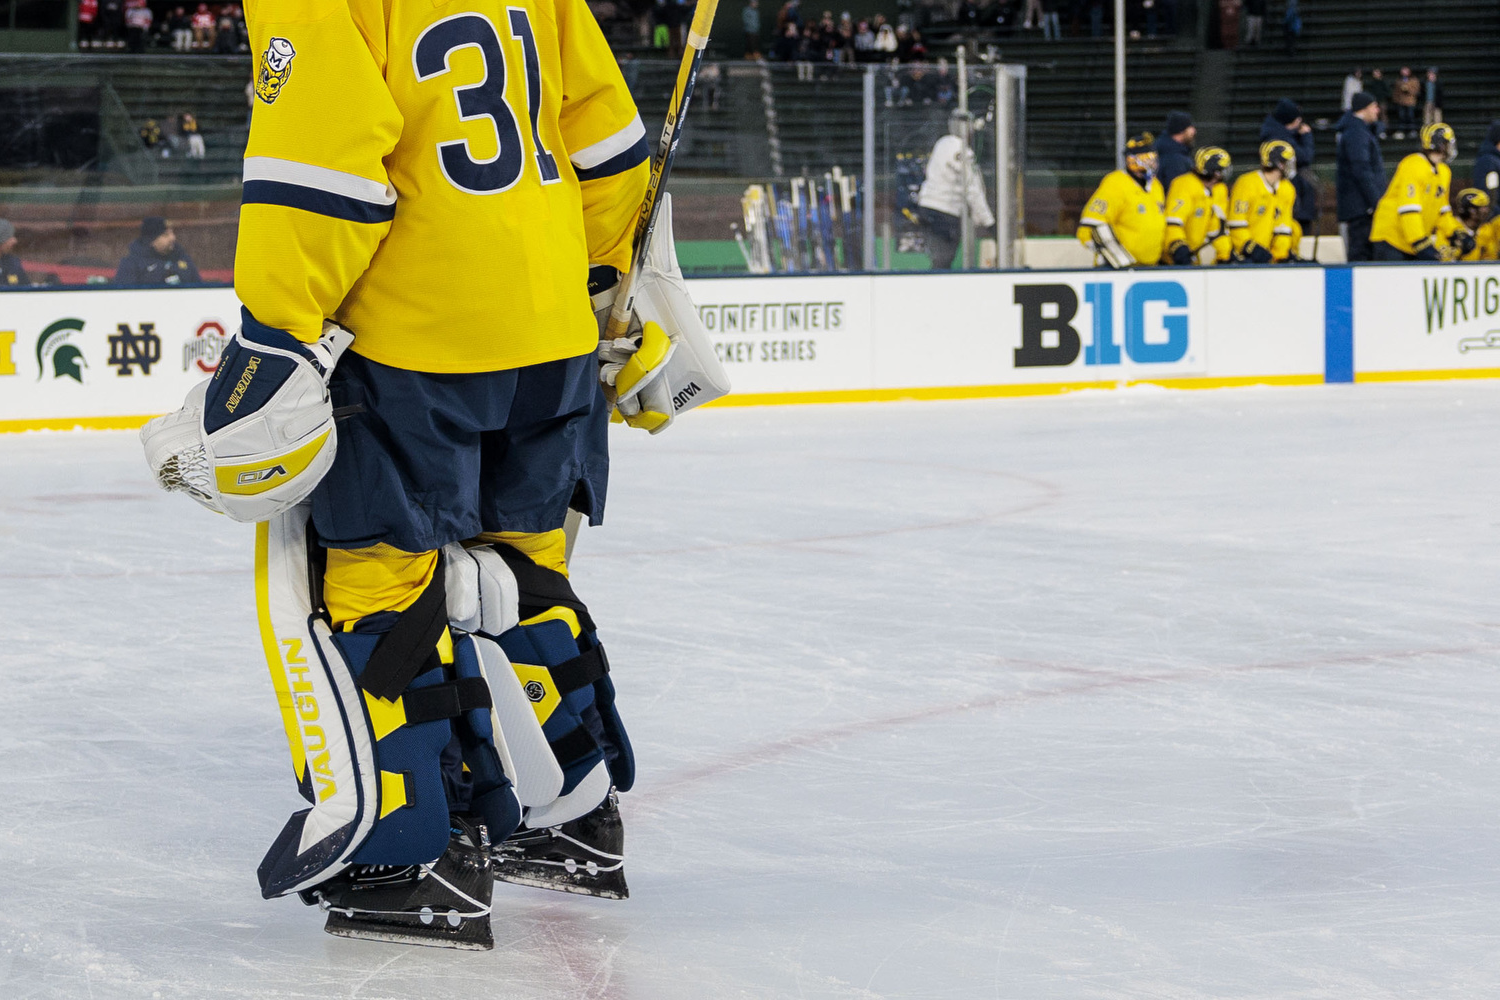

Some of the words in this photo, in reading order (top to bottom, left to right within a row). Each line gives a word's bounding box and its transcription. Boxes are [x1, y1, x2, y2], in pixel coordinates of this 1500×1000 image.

[411, 5, 563, 196] 31
[1423, 276, 1500, 336] WRIG
[760, 339, 816, 362] SERIES
[225, 355, 262, 414] VAUGHN
[281, 637, 339, 802] VAUGHN
